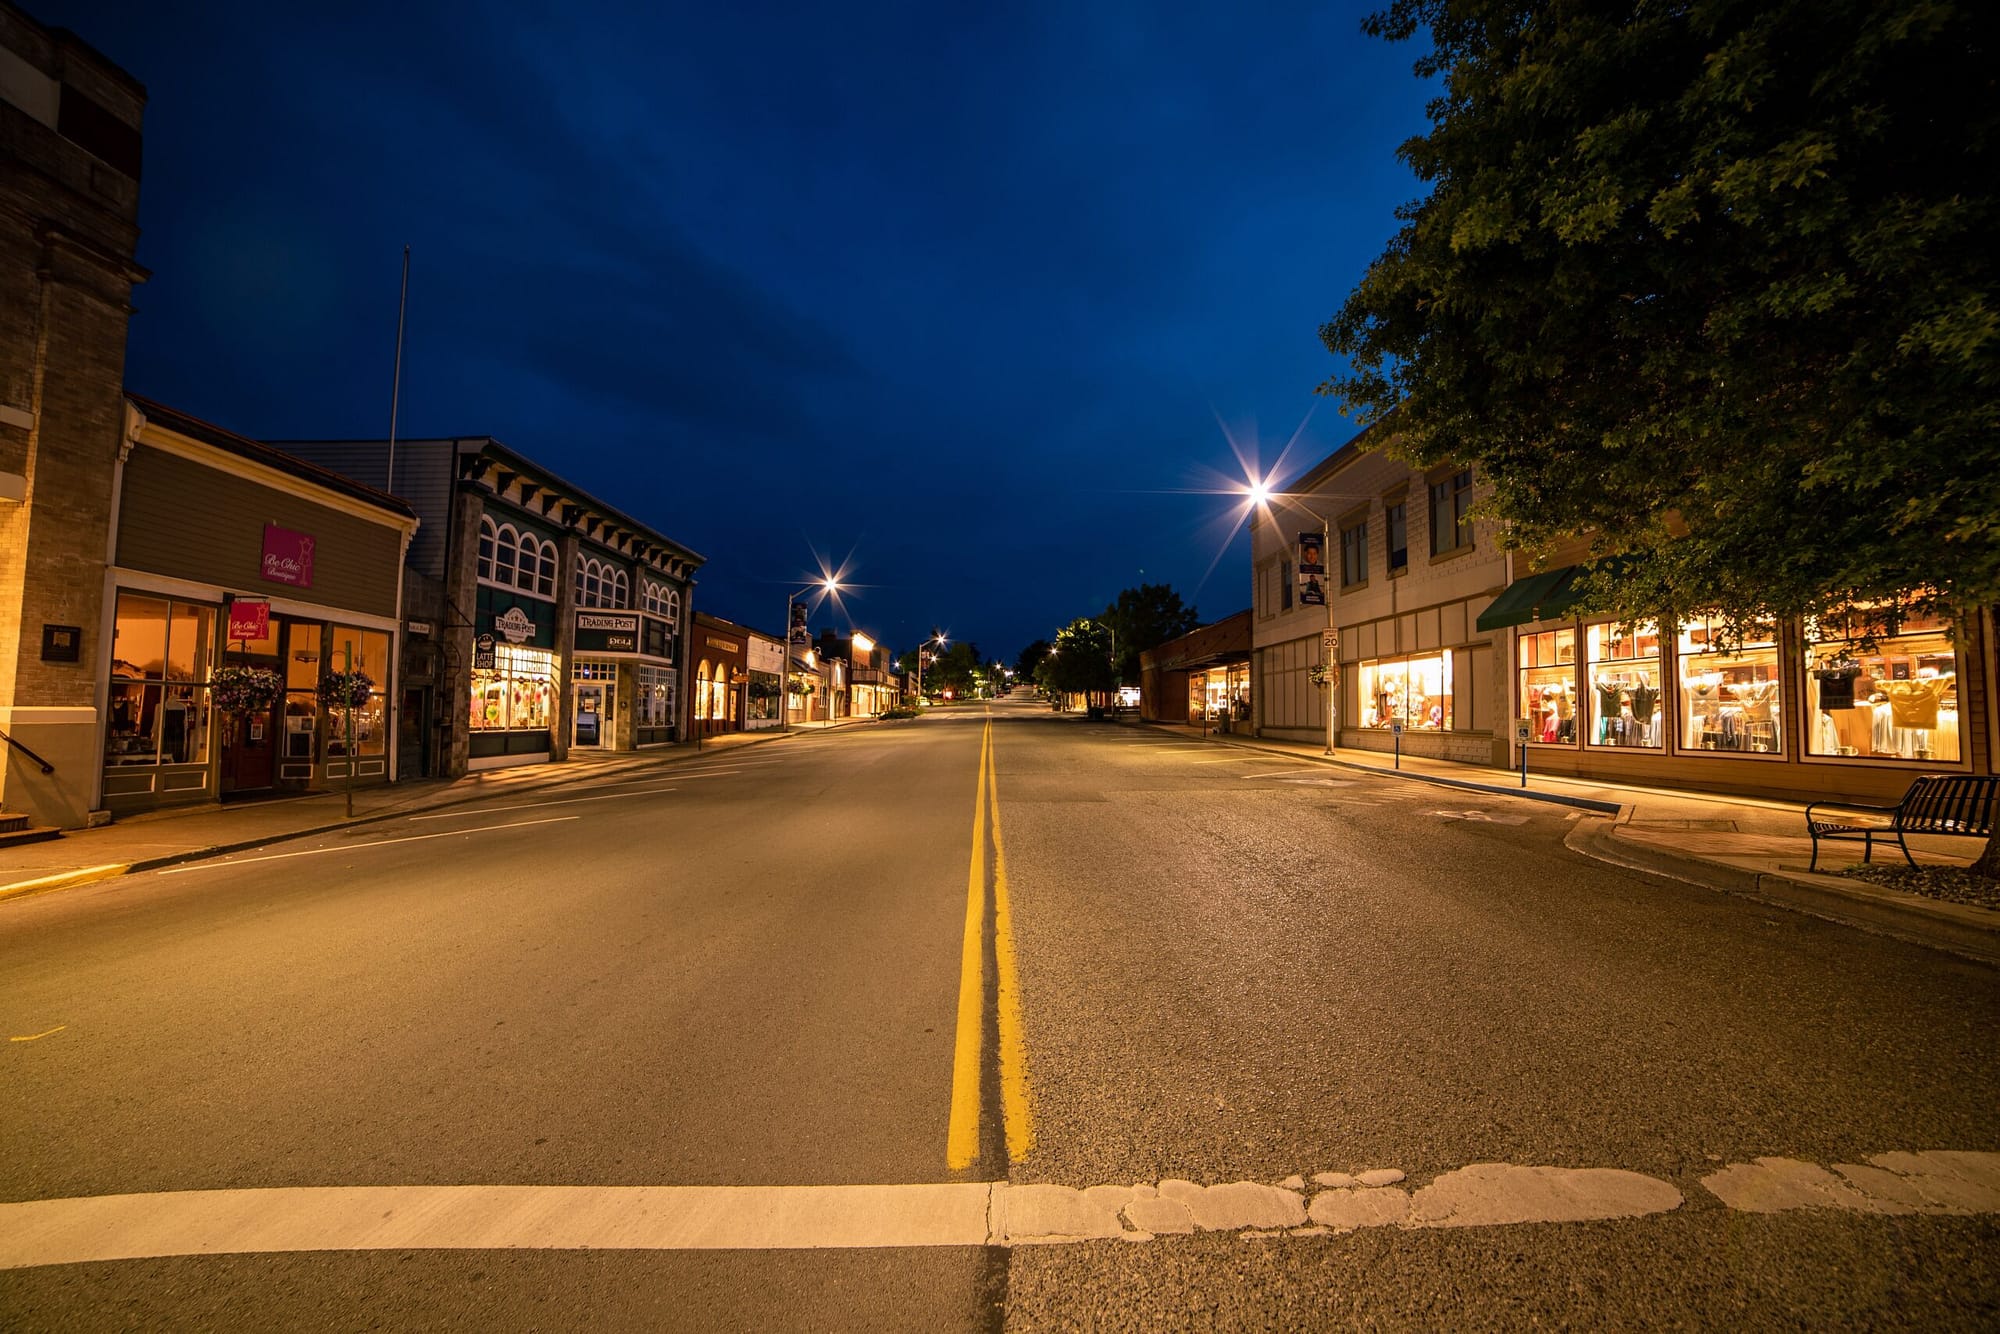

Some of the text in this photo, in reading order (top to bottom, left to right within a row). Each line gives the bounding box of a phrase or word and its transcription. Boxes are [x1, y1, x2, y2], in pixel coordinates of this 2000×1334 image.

[265, 553, 301, 571] Be Chic
[267, 567, 297, 581] Boutique
[231, 621, 243, 630] Be
[497, 618, 534, 634] TRADING POST
[581, 616, 635, 628] TRADING POST
[1324, 638, 1338, 647] 20
[476, 652, 494, 661] LATTE
[476, 660, 494, 668] SHOP
